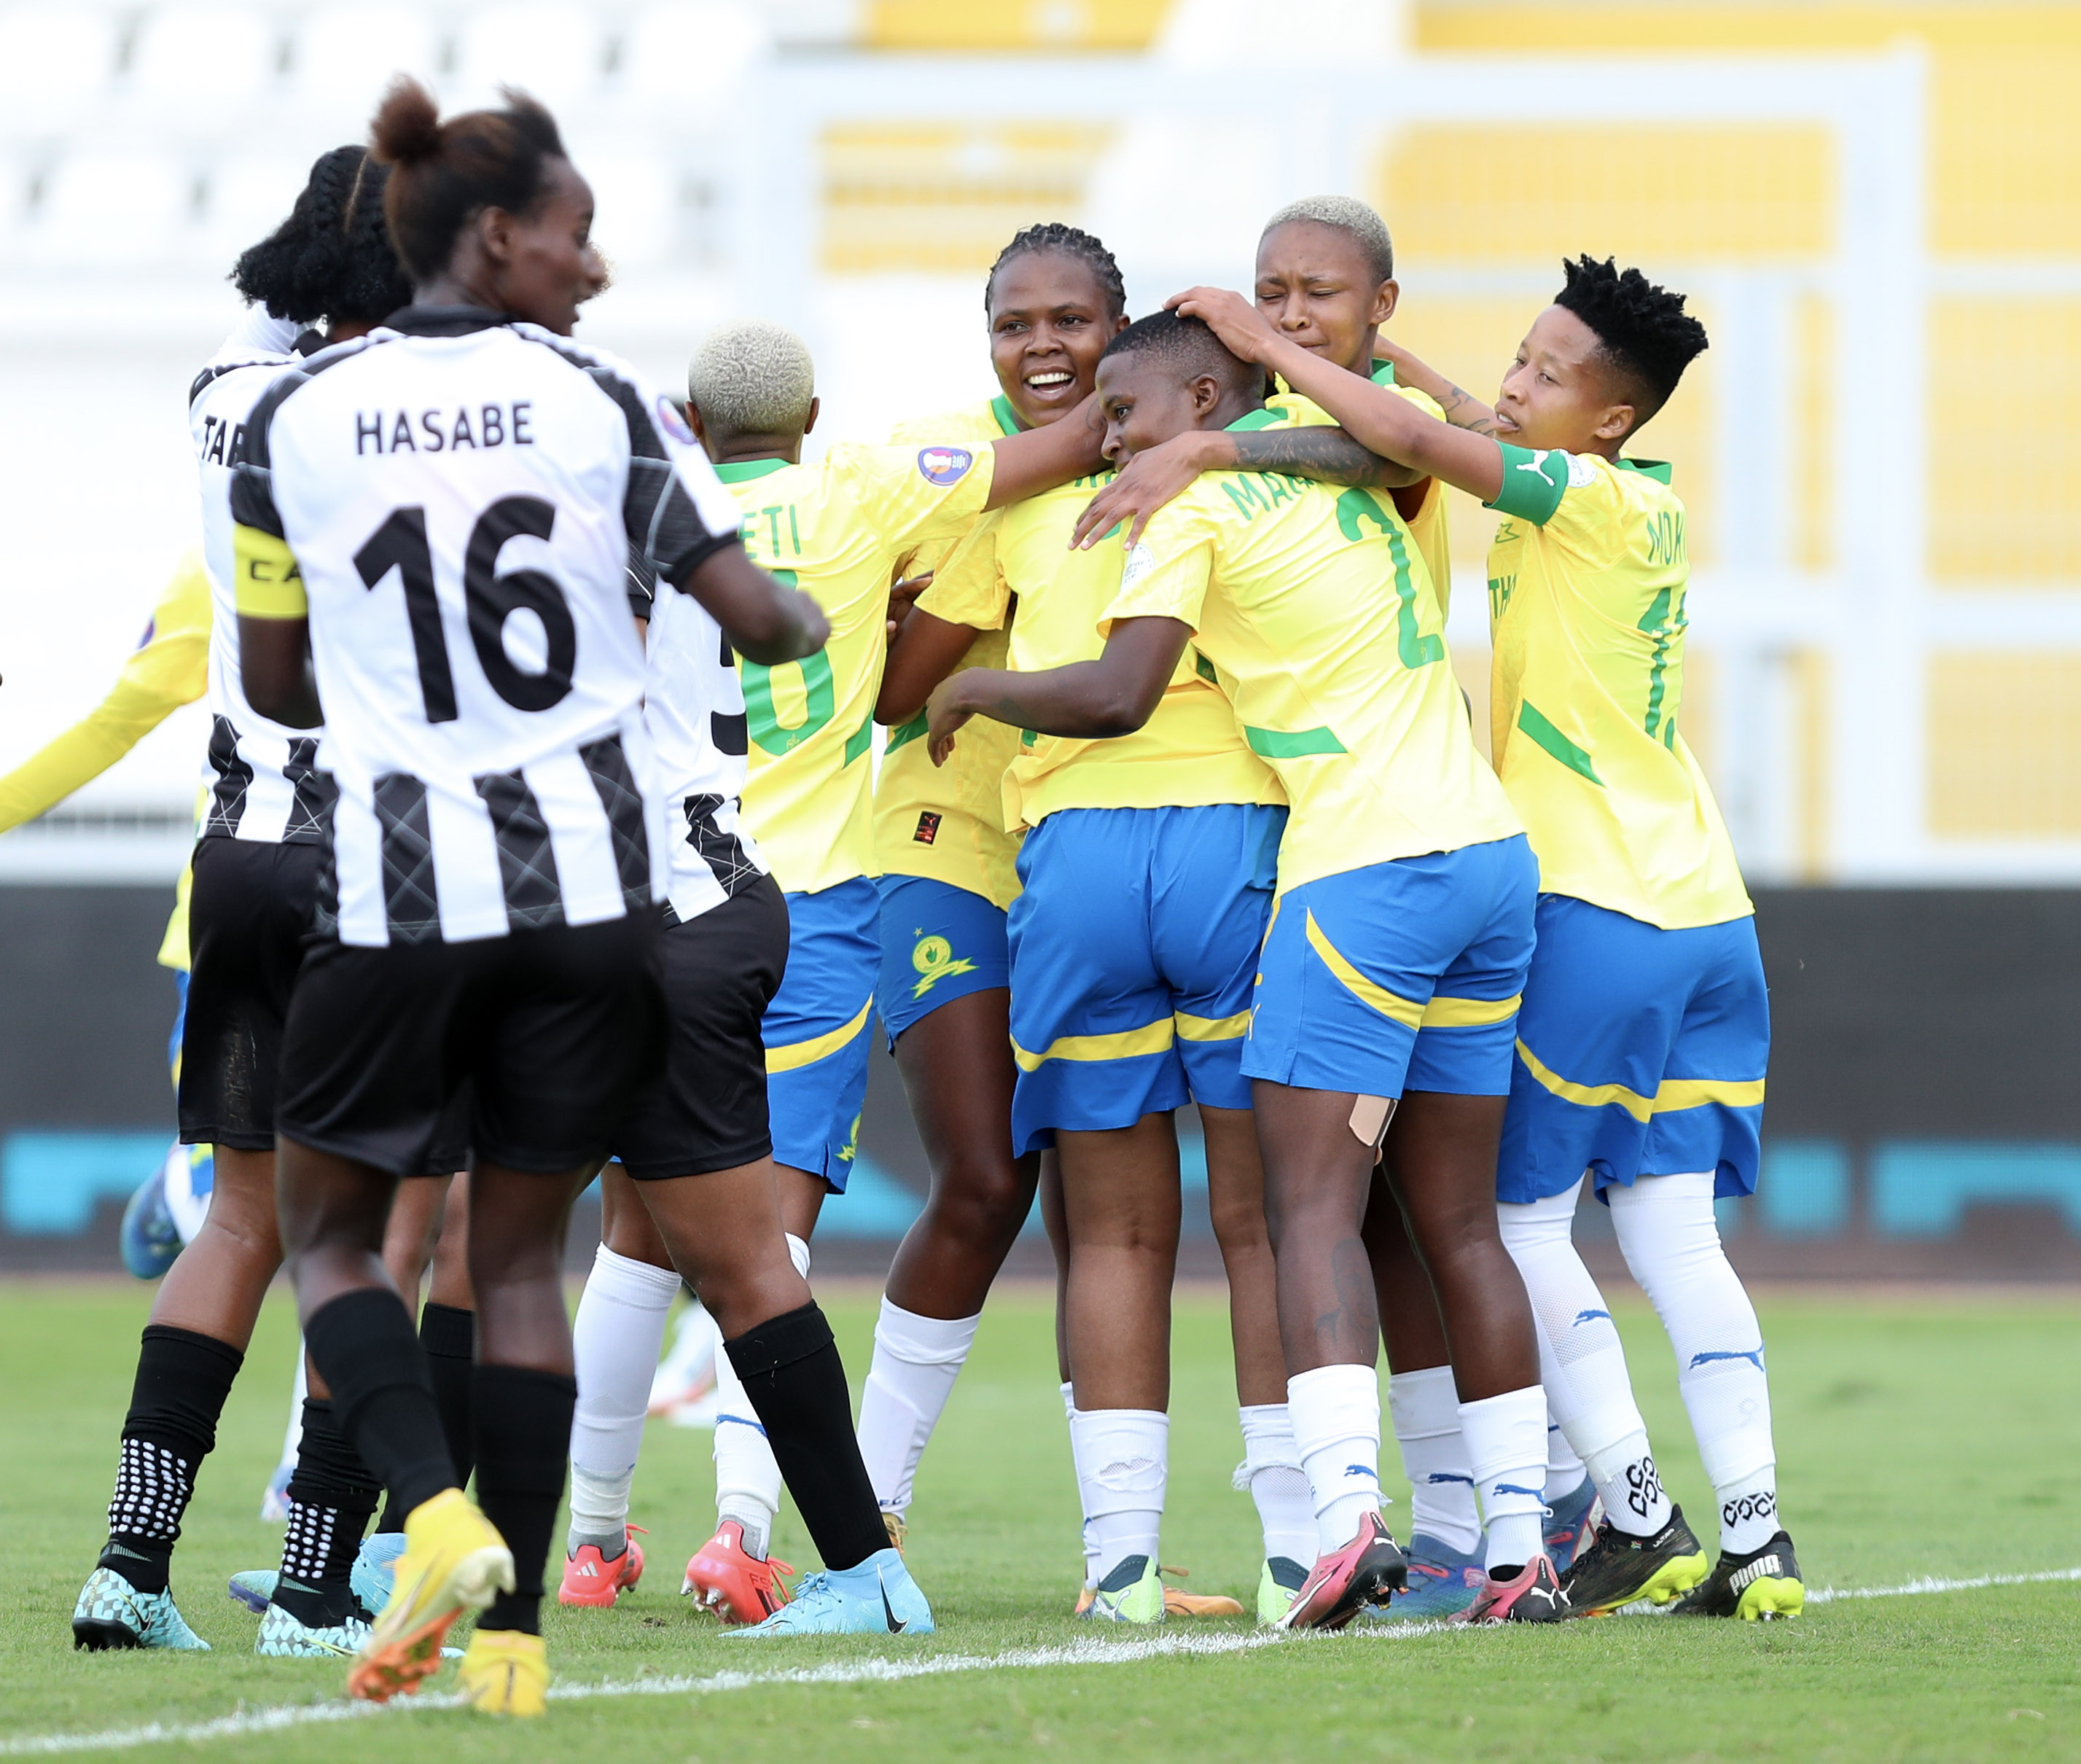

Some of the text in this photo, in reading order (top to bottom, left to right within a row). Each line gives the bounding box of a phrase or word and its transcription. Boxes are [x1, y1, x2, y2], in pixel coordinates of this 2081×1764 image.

[356, 402, 534, 456] HASABE
[1647, 511, 1687, 565] MOK
[1336, 487, 1445, 669] 2
[351, 493, 577, 724] 16
[1652, 1528, 1676, 1548] ULTRA
[1729, 1554, 1781, 1596] PUMA
